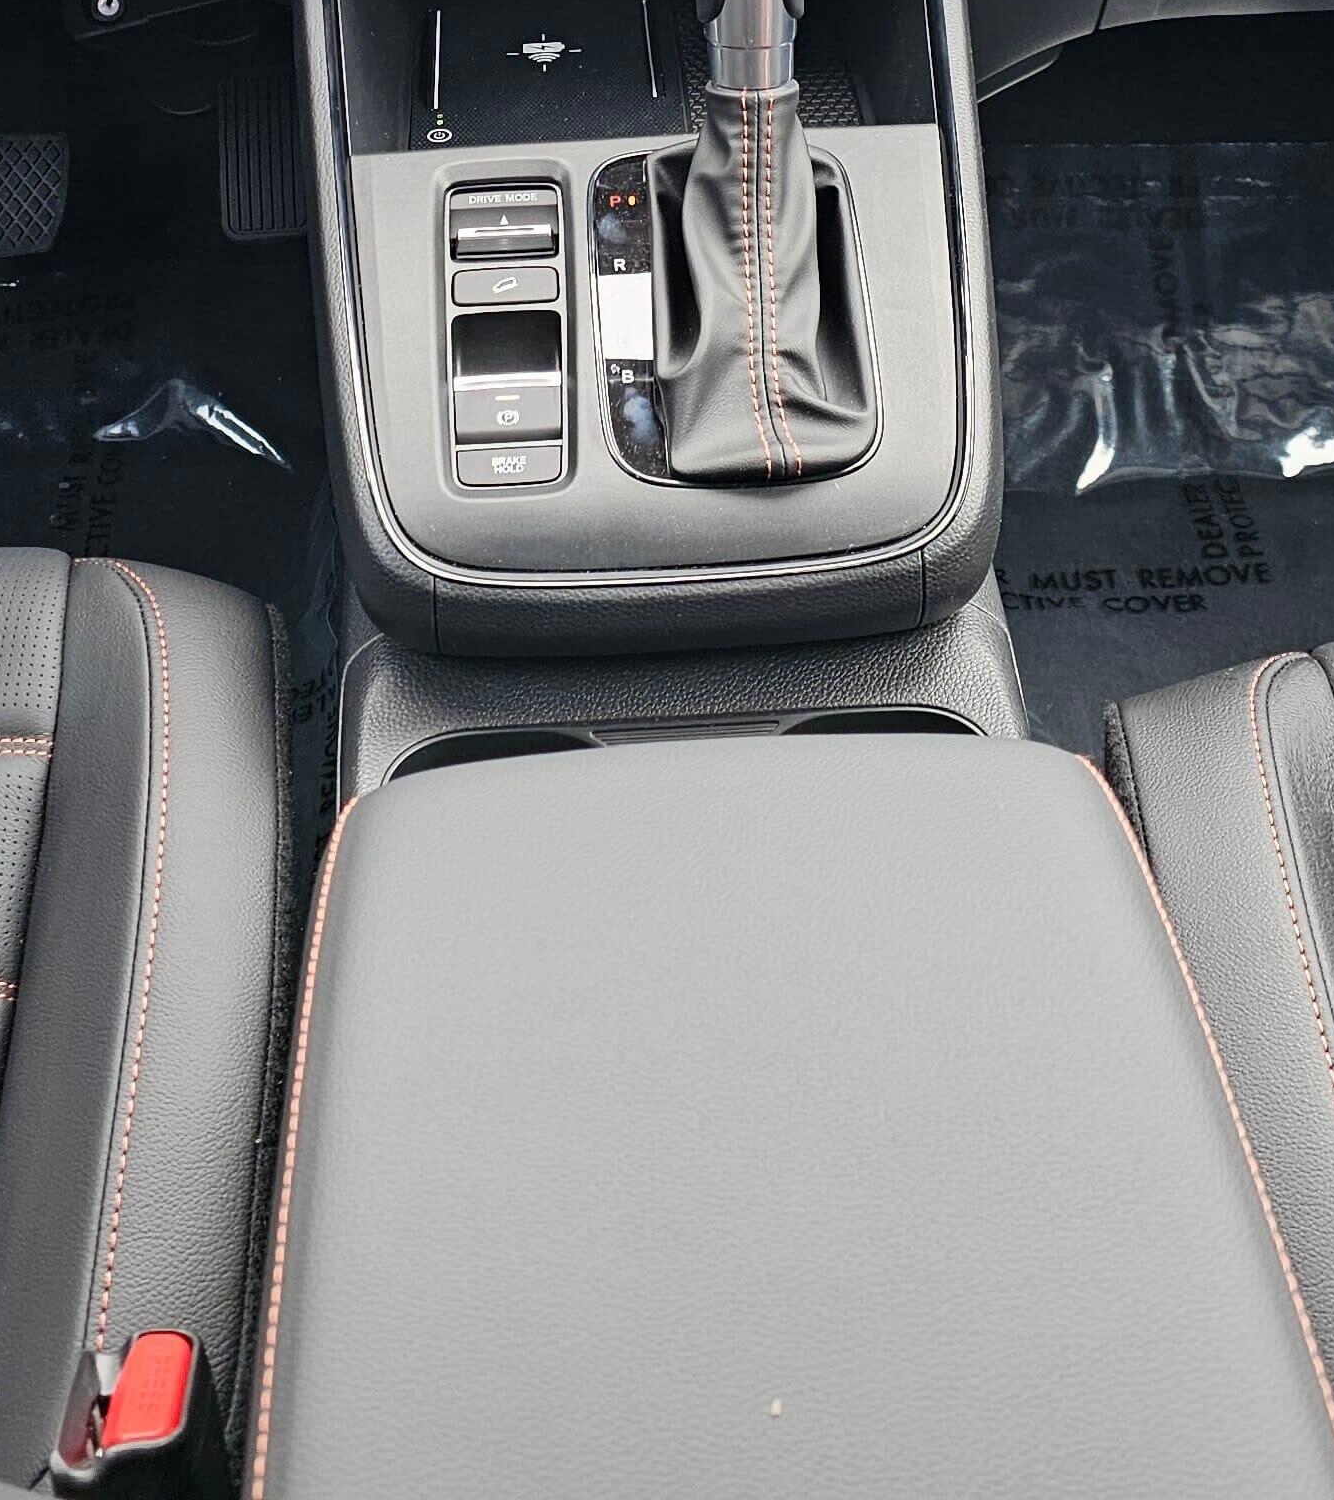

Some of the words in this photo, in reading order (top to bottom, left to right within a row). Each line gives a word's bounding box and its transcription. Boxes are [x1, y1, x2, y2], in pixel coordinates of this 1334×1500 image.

[468, 194, 501, 205] DRIVE
[505, 192, 538, 203] MODE
[609, 195, 622, 208] P
[613, 257, 627, 272] R
[622, 369, 635, 384] B
[491, 455, 527, 467] BRAKE
[494, 464, 525, 475] HOLD
[1030, 568, 1117, 591] MUST
[1138, 562, 1275, 590] REMOVE
[1102, 594, 1208, 613] COVER
